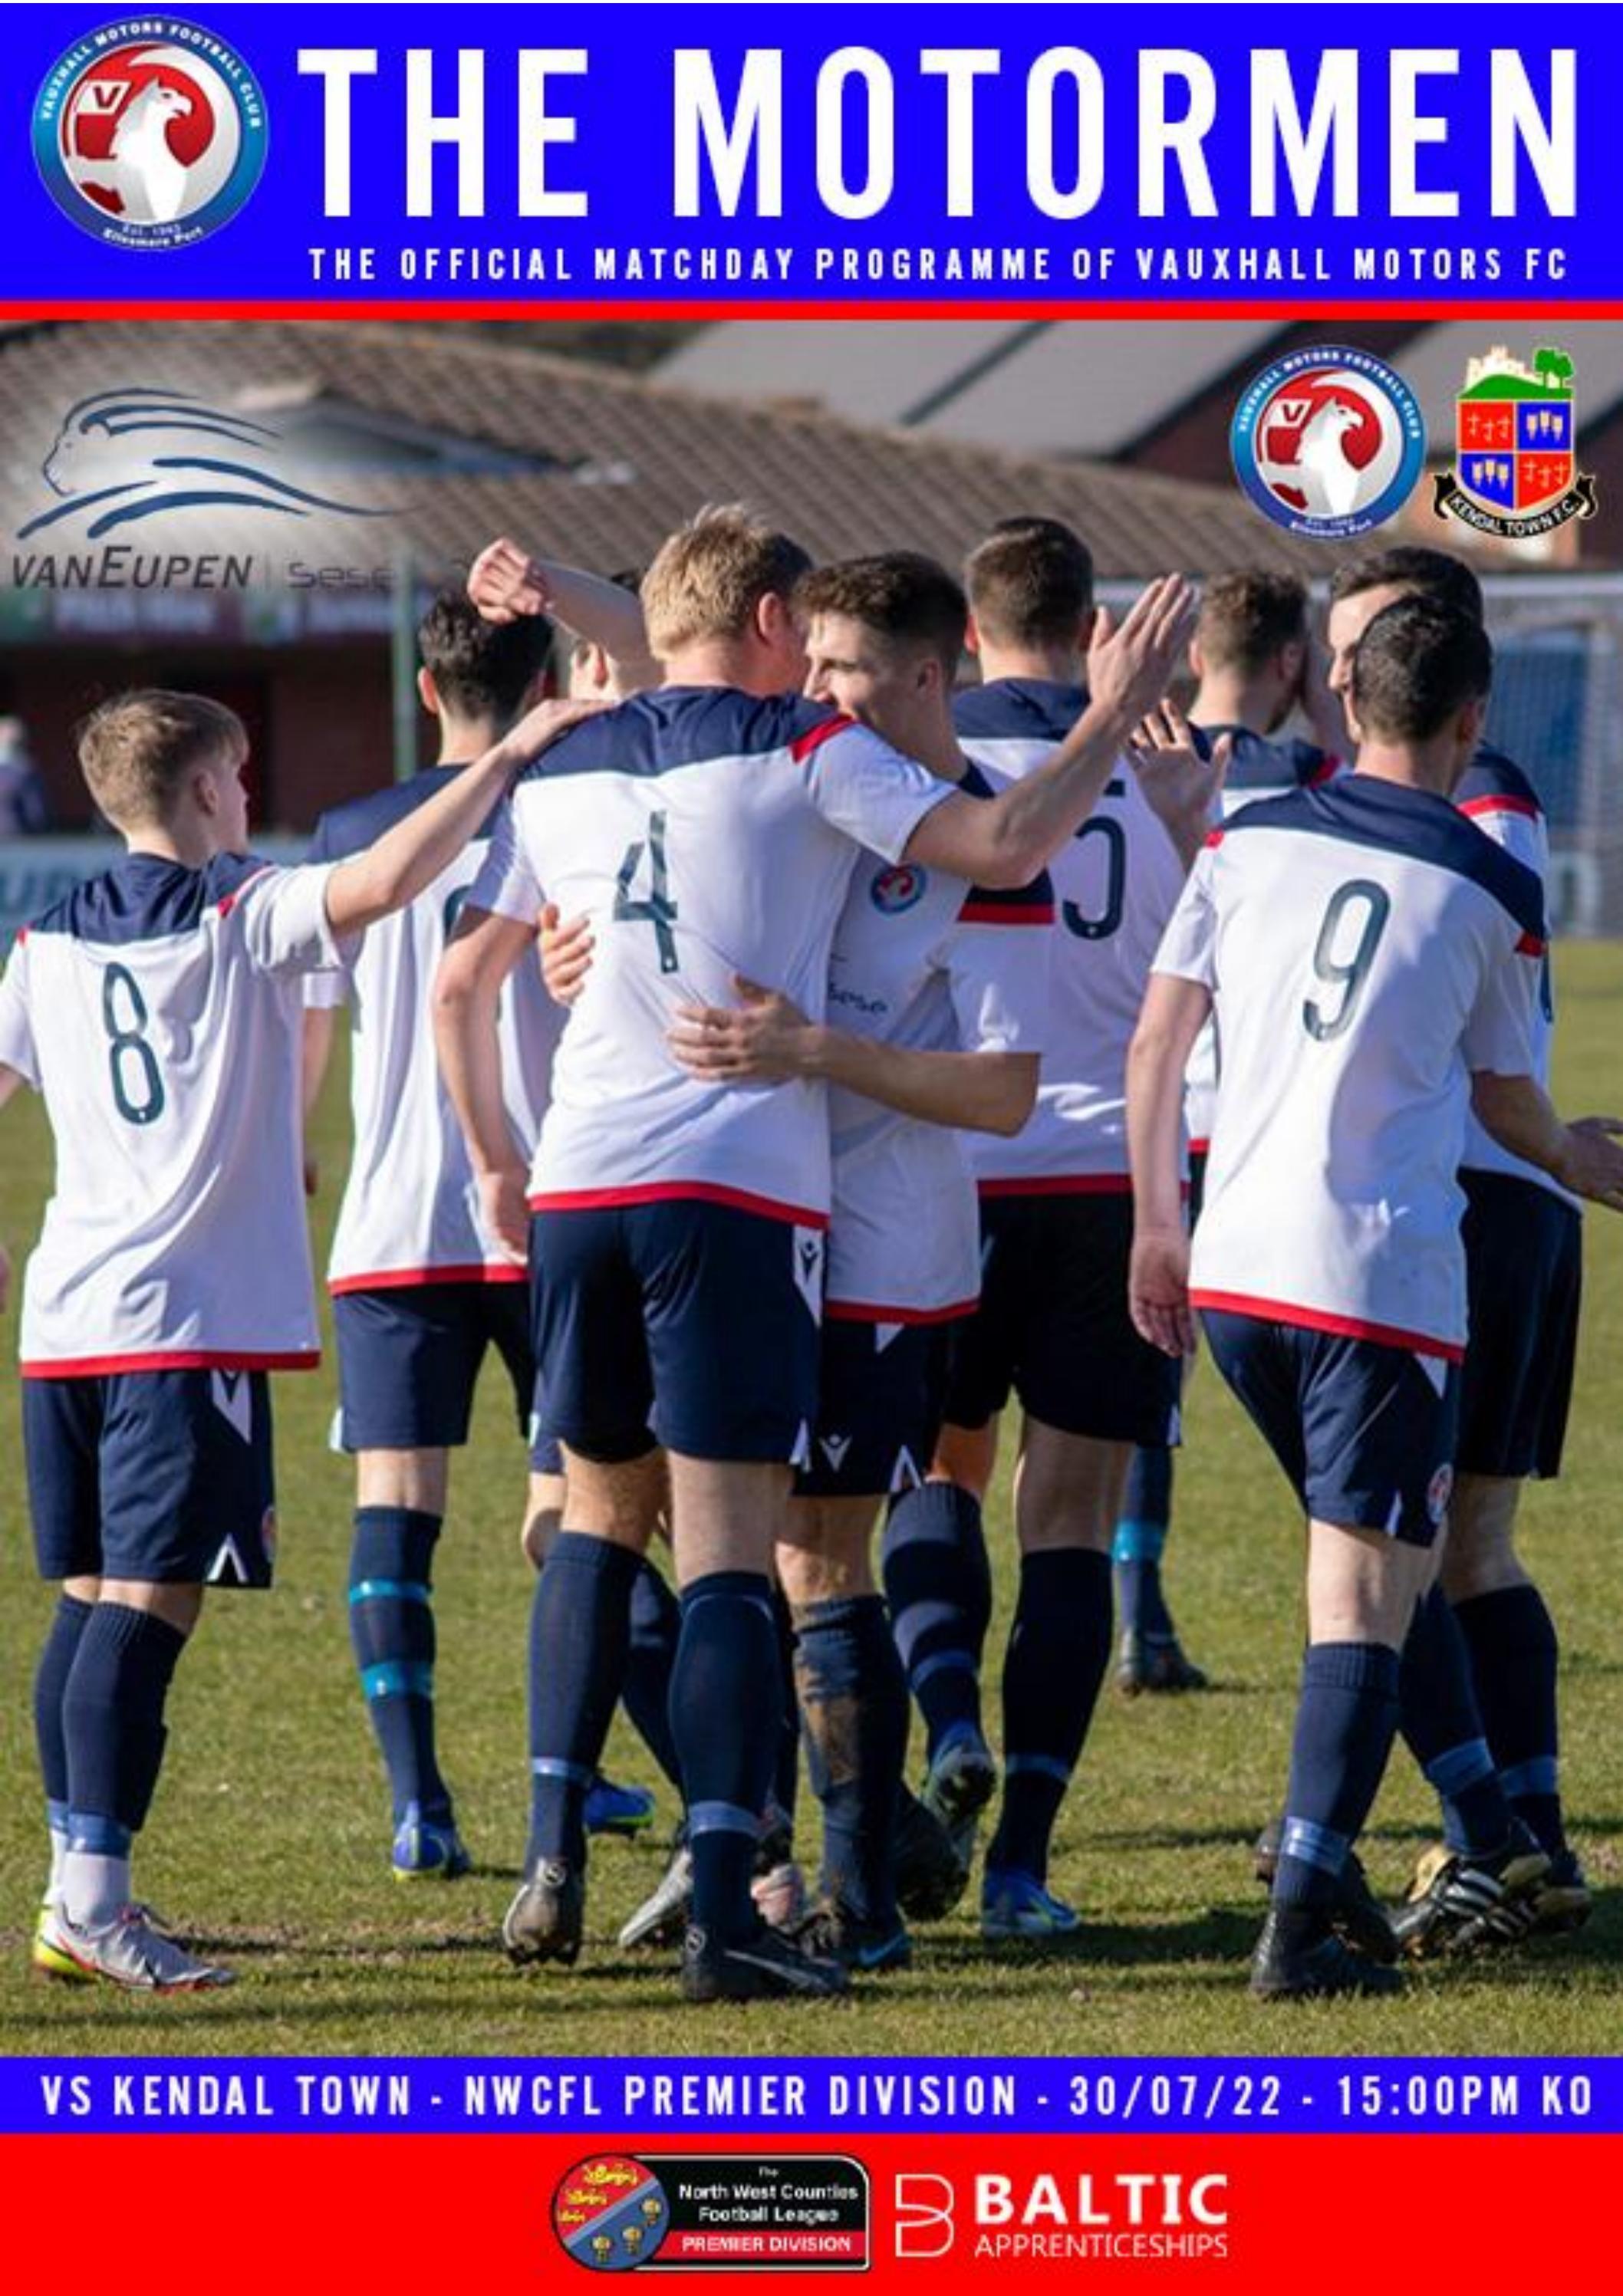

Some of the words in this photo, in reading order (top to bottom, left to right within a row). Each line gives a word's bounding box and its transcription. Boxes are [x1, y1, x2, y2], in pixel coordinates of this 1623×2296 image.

[614, 809, 679, 974] 4
[1303, 879, 1391, 1041] 9
[102, 962, 166, 1125] 8
